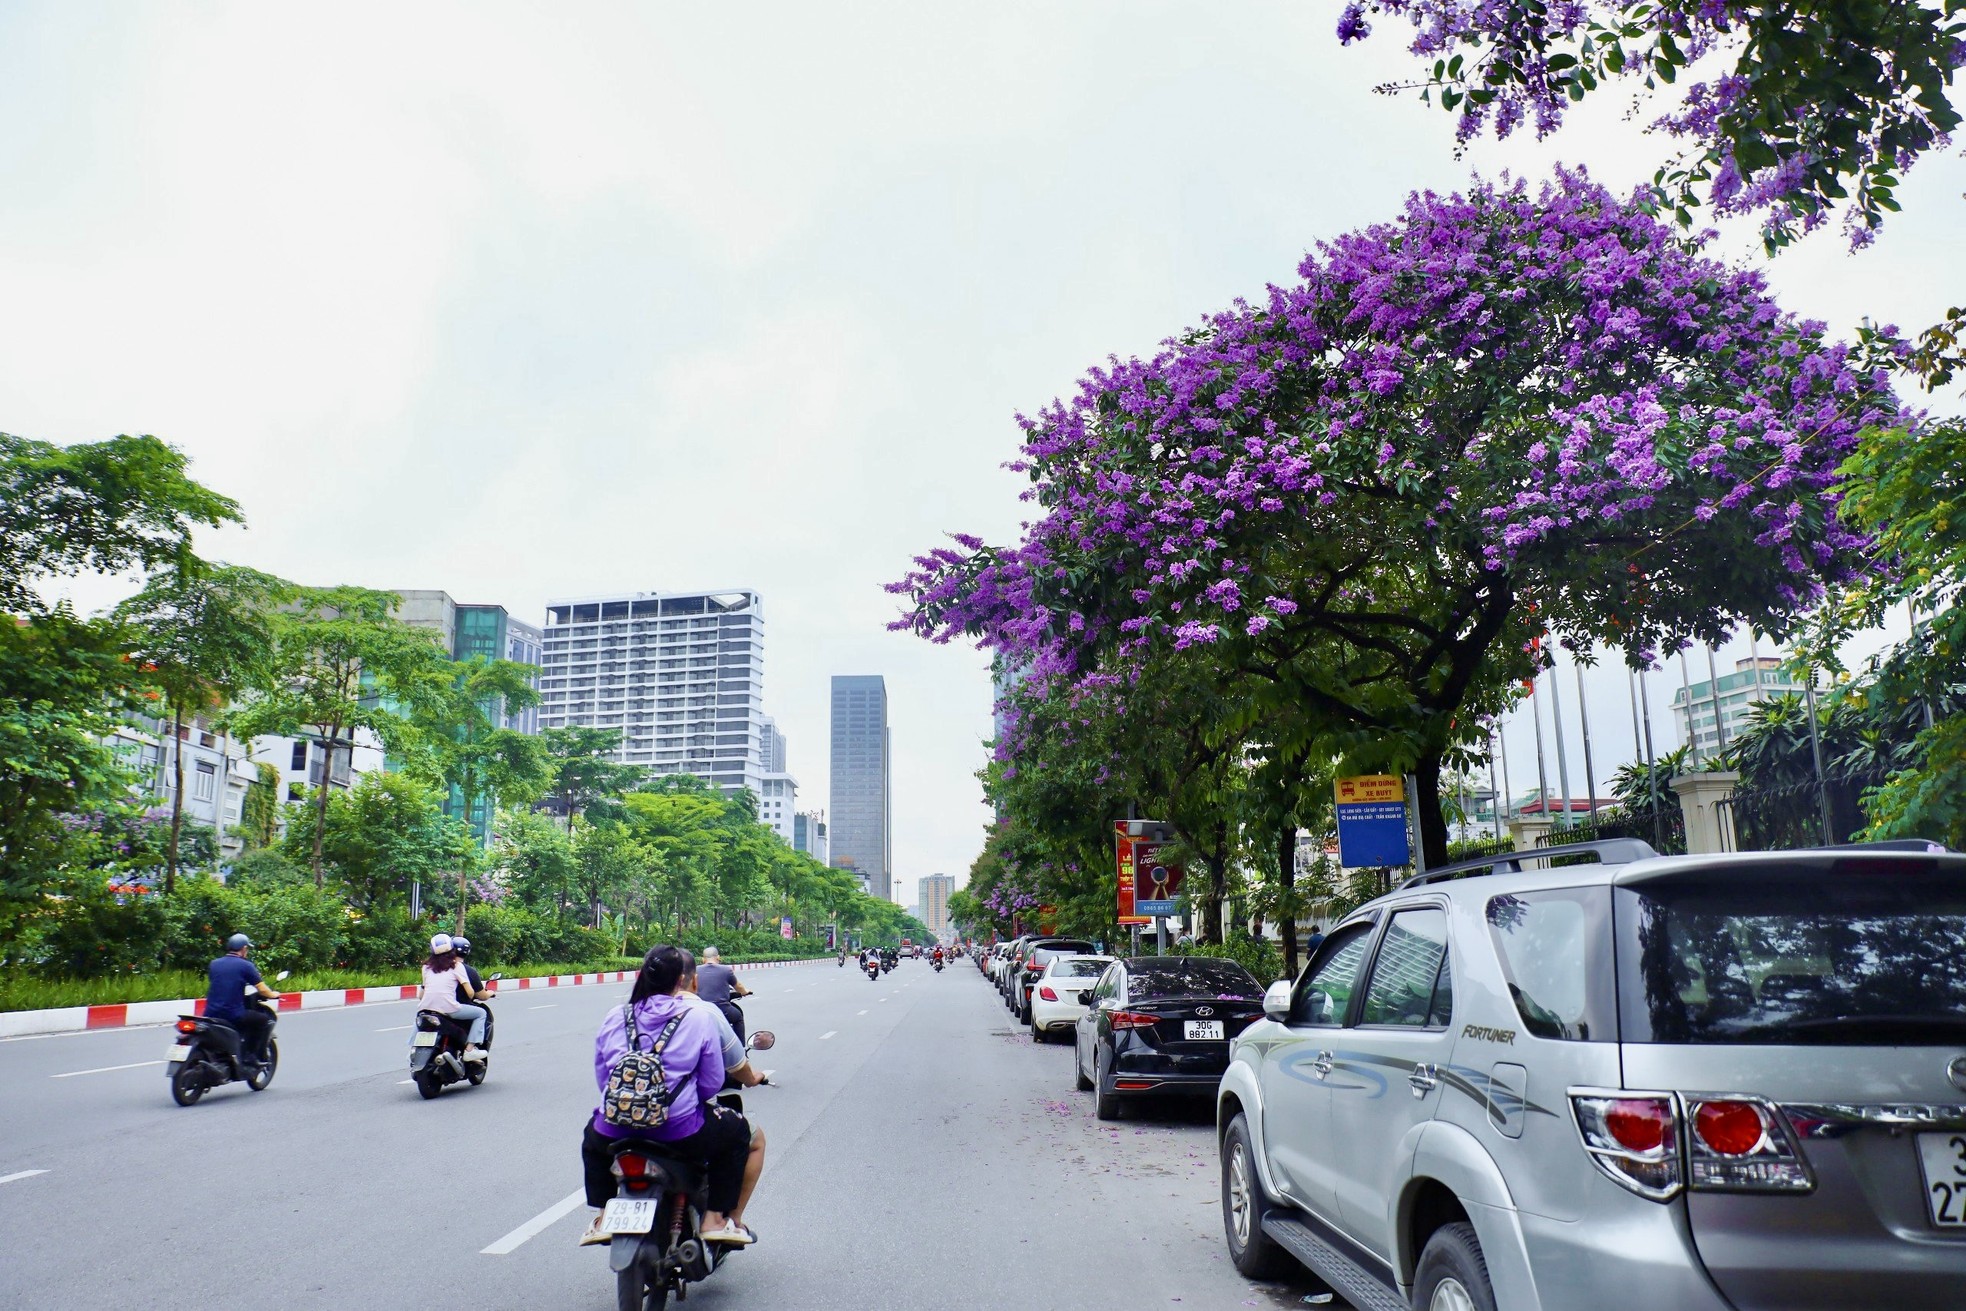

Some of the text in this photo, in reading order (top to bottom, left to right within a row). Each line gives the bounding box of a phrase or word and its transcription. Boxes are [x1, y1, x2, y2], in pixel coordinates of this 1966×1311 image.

[1195, 1021, 1212, 1030] 30G
[1189, 1030, 1219, 1039] 882.11
[1461, 1024, 1516, 1046] FORTUNER
[612, 1201, 648, 1215] 29-B1
